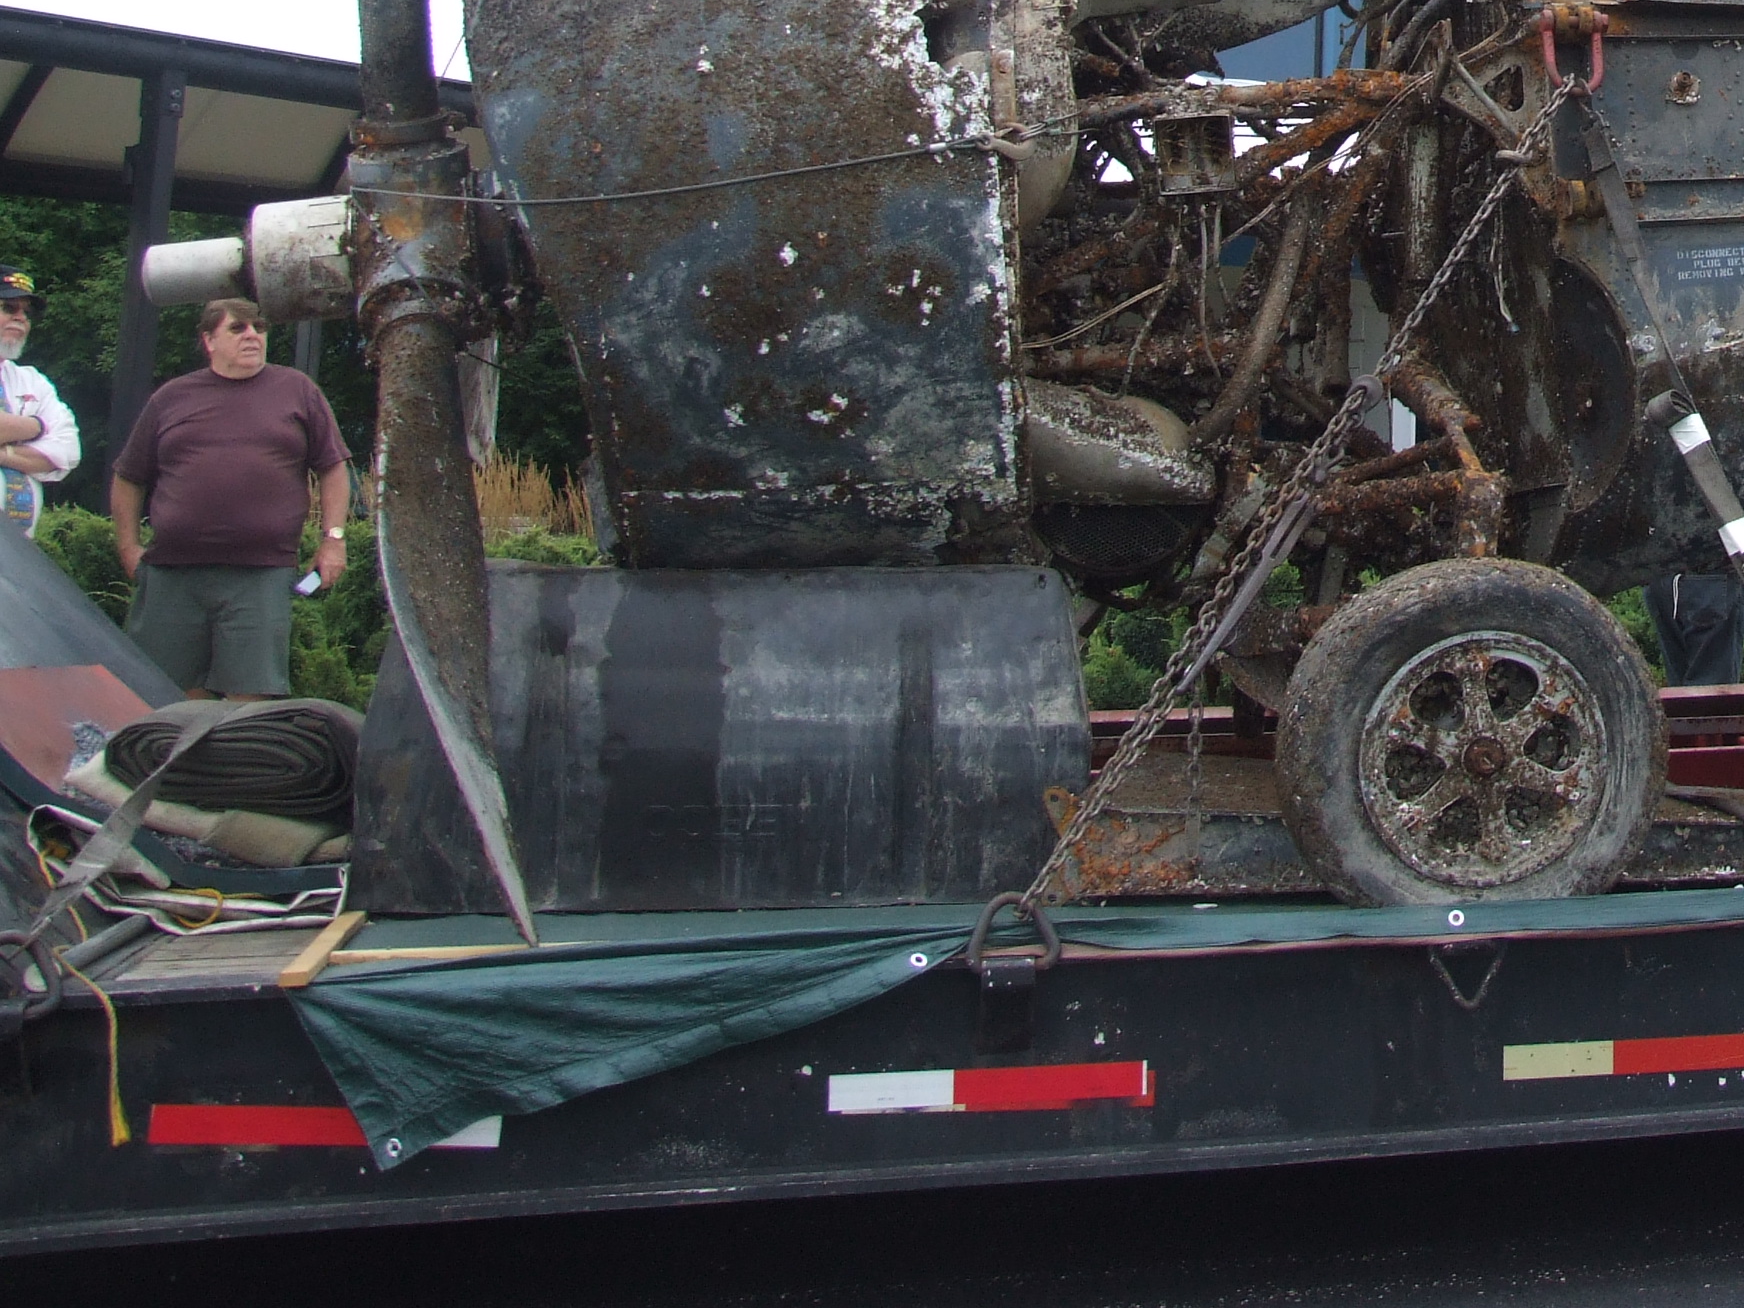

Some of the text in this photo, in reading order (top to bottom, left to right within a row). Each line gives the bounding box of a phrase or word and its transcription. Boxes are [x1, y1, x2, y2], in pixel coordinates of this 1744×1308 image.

[1676, 247, 1744, 260] DISCONNECT
[1693, 259, 1721, 269] PLUG
[1678, 268, 1734, 280] REMOVING
